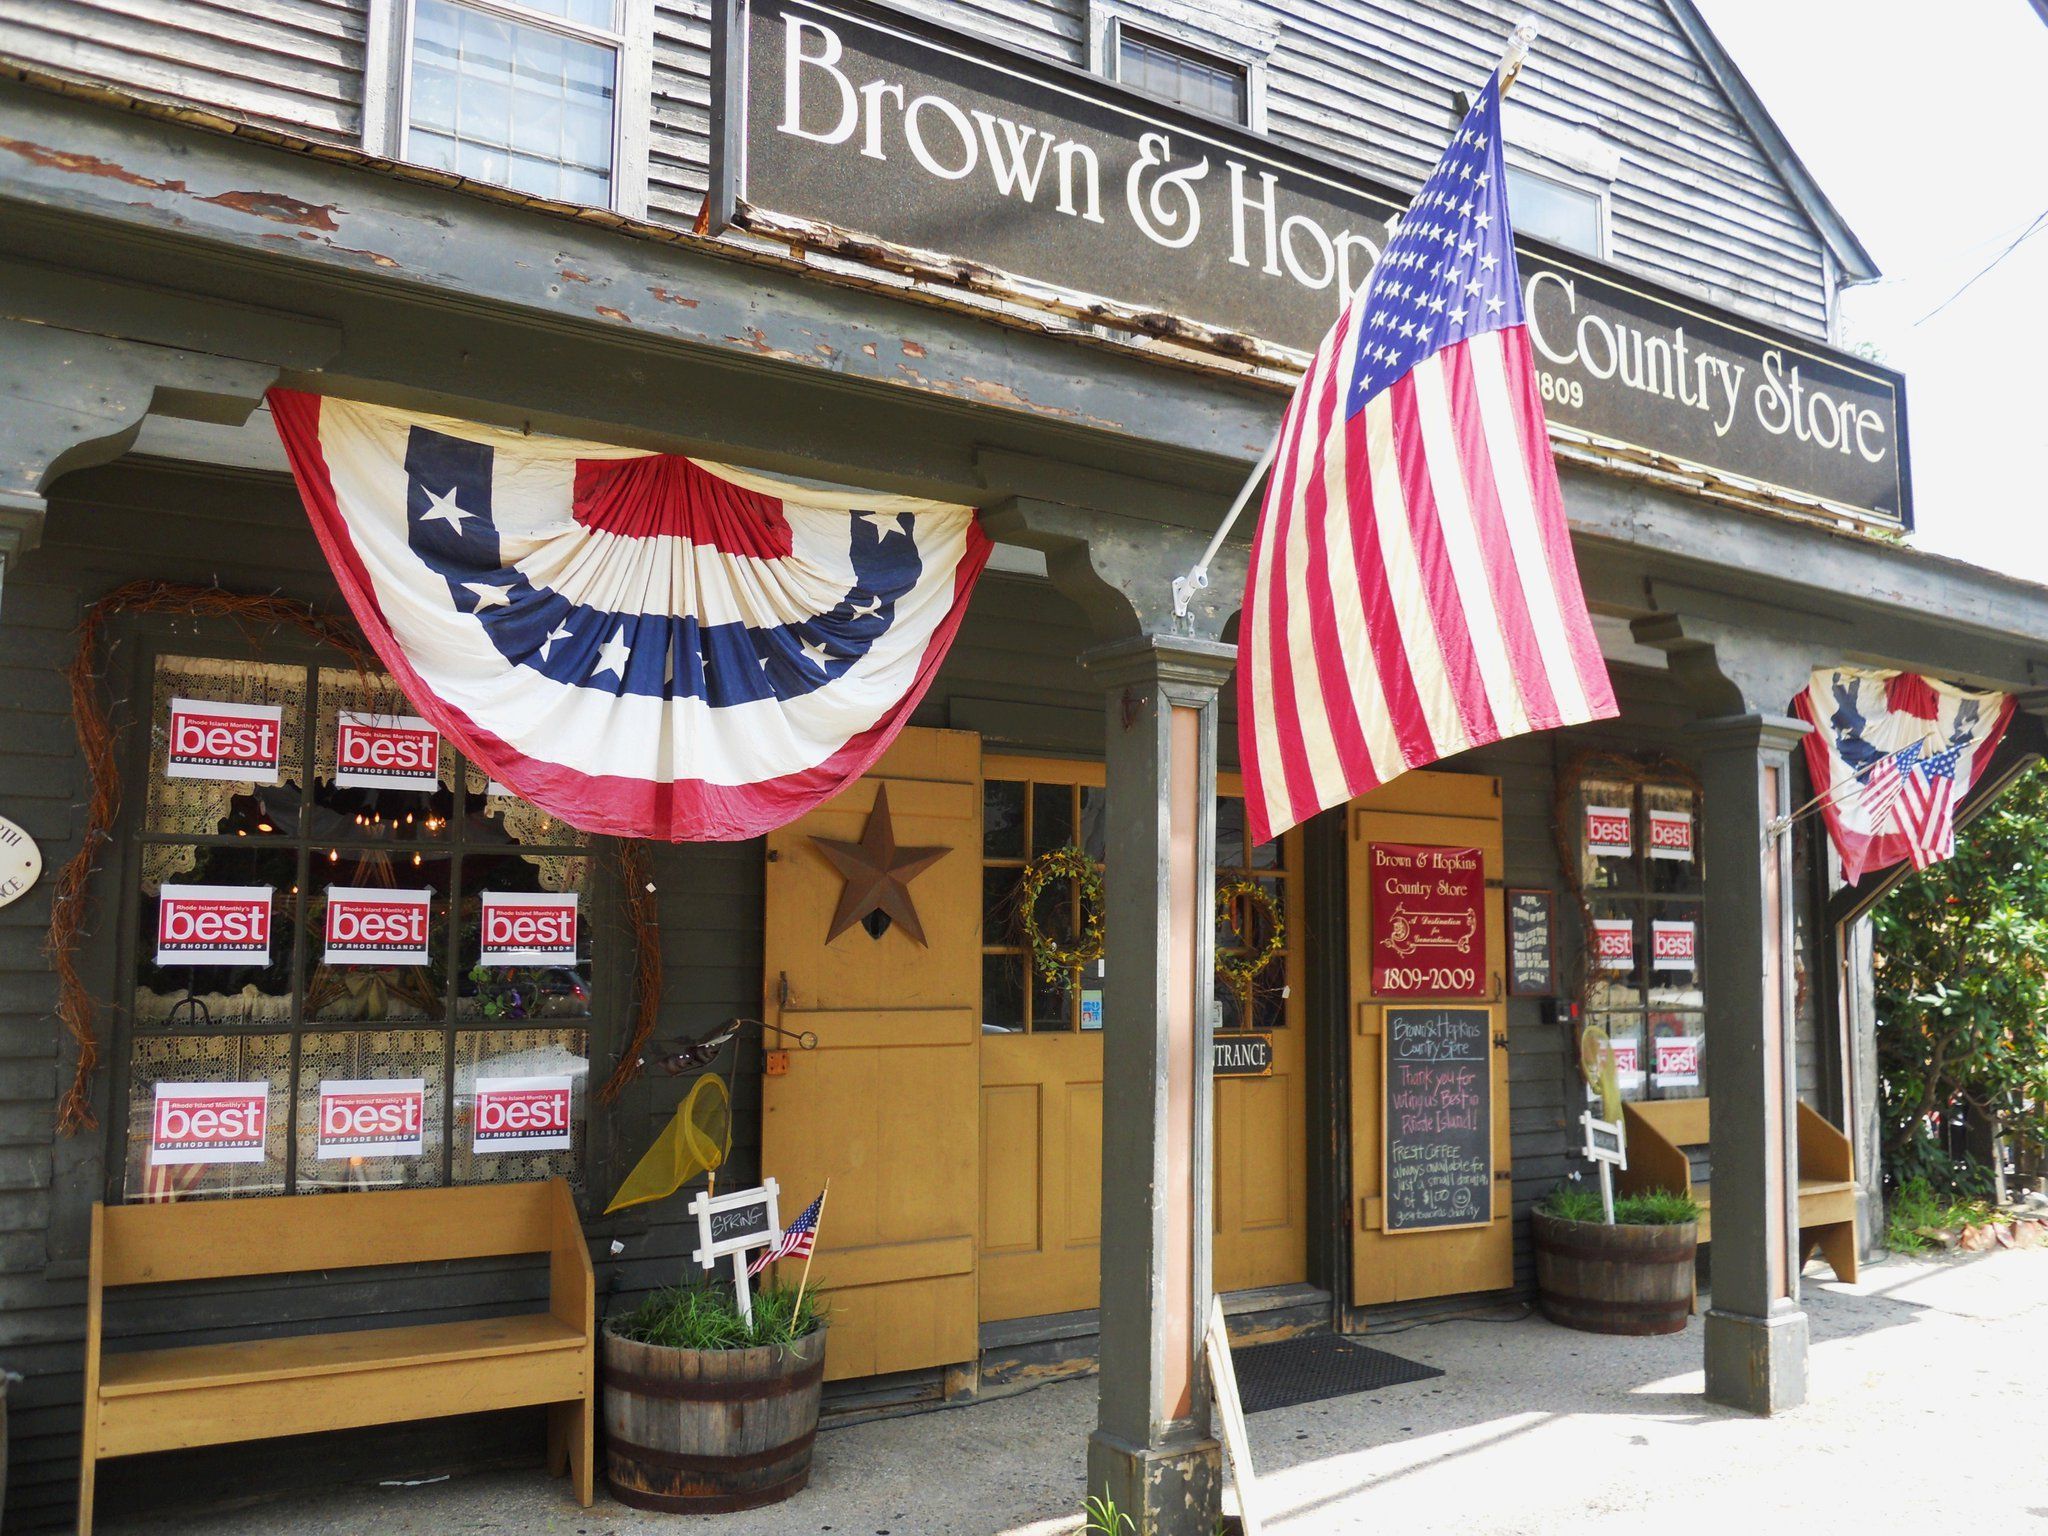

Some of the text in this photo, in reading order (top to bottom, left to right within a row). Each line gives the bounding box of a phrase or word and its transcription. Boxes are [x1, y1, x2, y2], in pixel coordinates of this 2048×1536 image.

[777, 12, 1886, 463] Brown & Hop Country Store
[176, 716, 274, 758] best
[344, 728, 434, 768] best
[1590, 816, 1628, 841] best
[1652, 820, 1688, 846] best
[1376, 850, 1476, 874] Brown & Hopkins
[1386, 878, 1468, 900] Country Store
[166, 902, 264, 940] best
[332, 904, 424, 940] best
[488, 908, 572, 942] best
[1655, 931, 1692, 954] best
[1382, 968, 1474, 989] 1809-2009
[1426, 1020, 1437, 1038] &
[1437, 1012, 1480, 1042] Hopkins
[1213, 1044, 1266, 1066] TRANCE
[1400, 1038, 1469, 1064] Country Store
[1660, 1047, 1696, 1072] best
[1398, 1065, 1476, 1097] Thank you for
[480, 1094, 565, 1129] best
[1441, 1090, 1468, 1109] Best
[160, 1101, 260, 1138] best
[326, 1098, 418, 1134] best
[712, 1206, 764, 1236] SPRING
